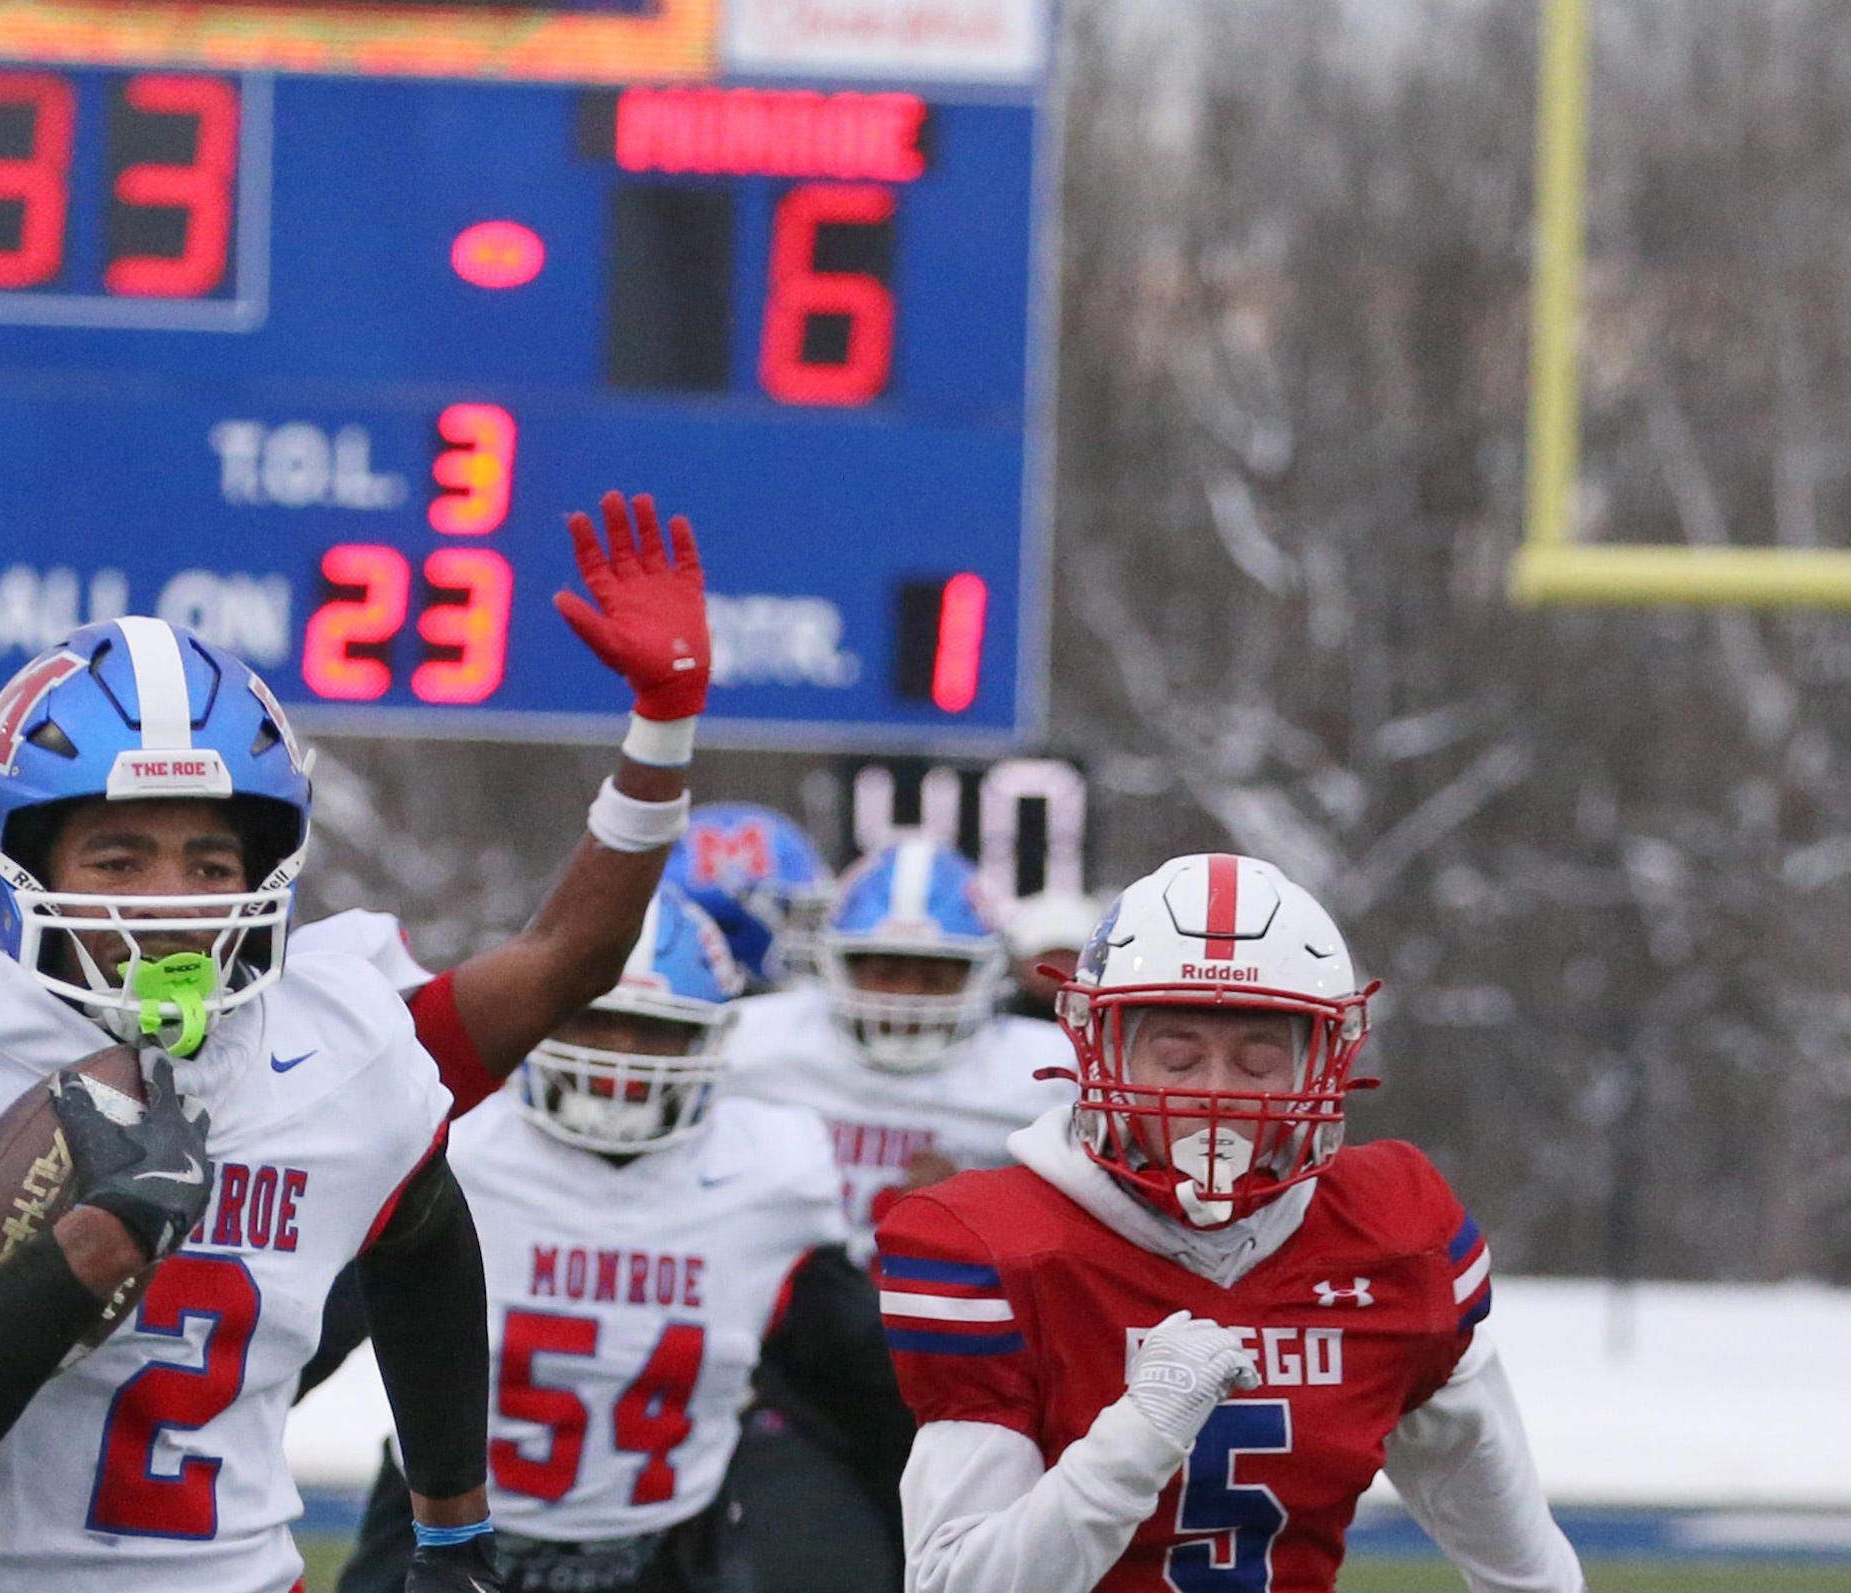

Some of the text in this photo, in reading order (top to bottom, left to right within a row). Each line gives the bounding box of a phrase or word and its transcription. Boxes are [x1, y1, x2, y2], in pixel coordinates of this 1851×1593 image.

[759, 184, 896, 407] 6
[428, 404, 517, 536] 3
[157, 568, 292, 668] ON
[303, 544, 514, 705] 23
[704, 572, 988, 713] TR. 1
[131, 761, 206, 777] THE ROE
[1181, 964, 1260, 983] Riddell
[189, 1161, 308, 1252] ROE
[530, 1242, 707, 1308] MONROE
[85, 1250, 262, 1541] 2
[487, 1306, 706, 1507] 54
